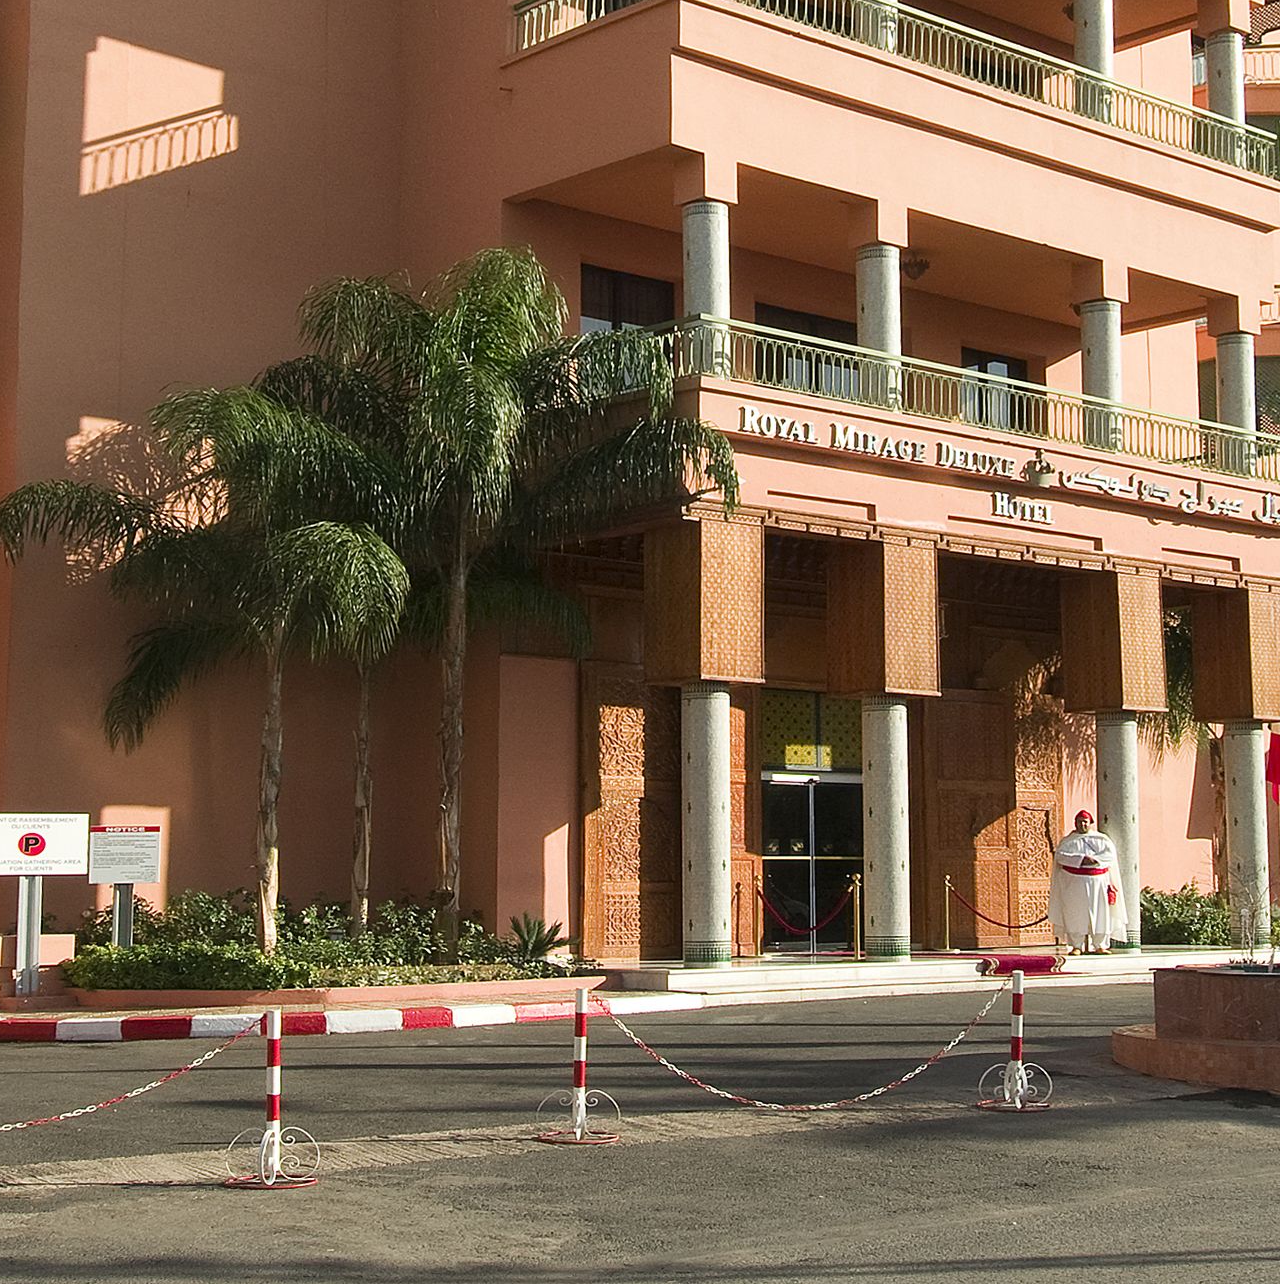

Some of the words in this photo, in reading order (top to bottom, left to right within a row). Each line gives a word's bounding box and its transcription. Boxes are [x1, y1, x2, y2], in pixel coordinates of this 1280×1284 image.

[739, 404, 820, 444] ROYAL
[829, 422, 926, 462] MIRAGE
[936, 441, 1015, 476] DELUXE
[991, 491, 1053, 524] HOTEL
[24, 836, 40, 852] P
